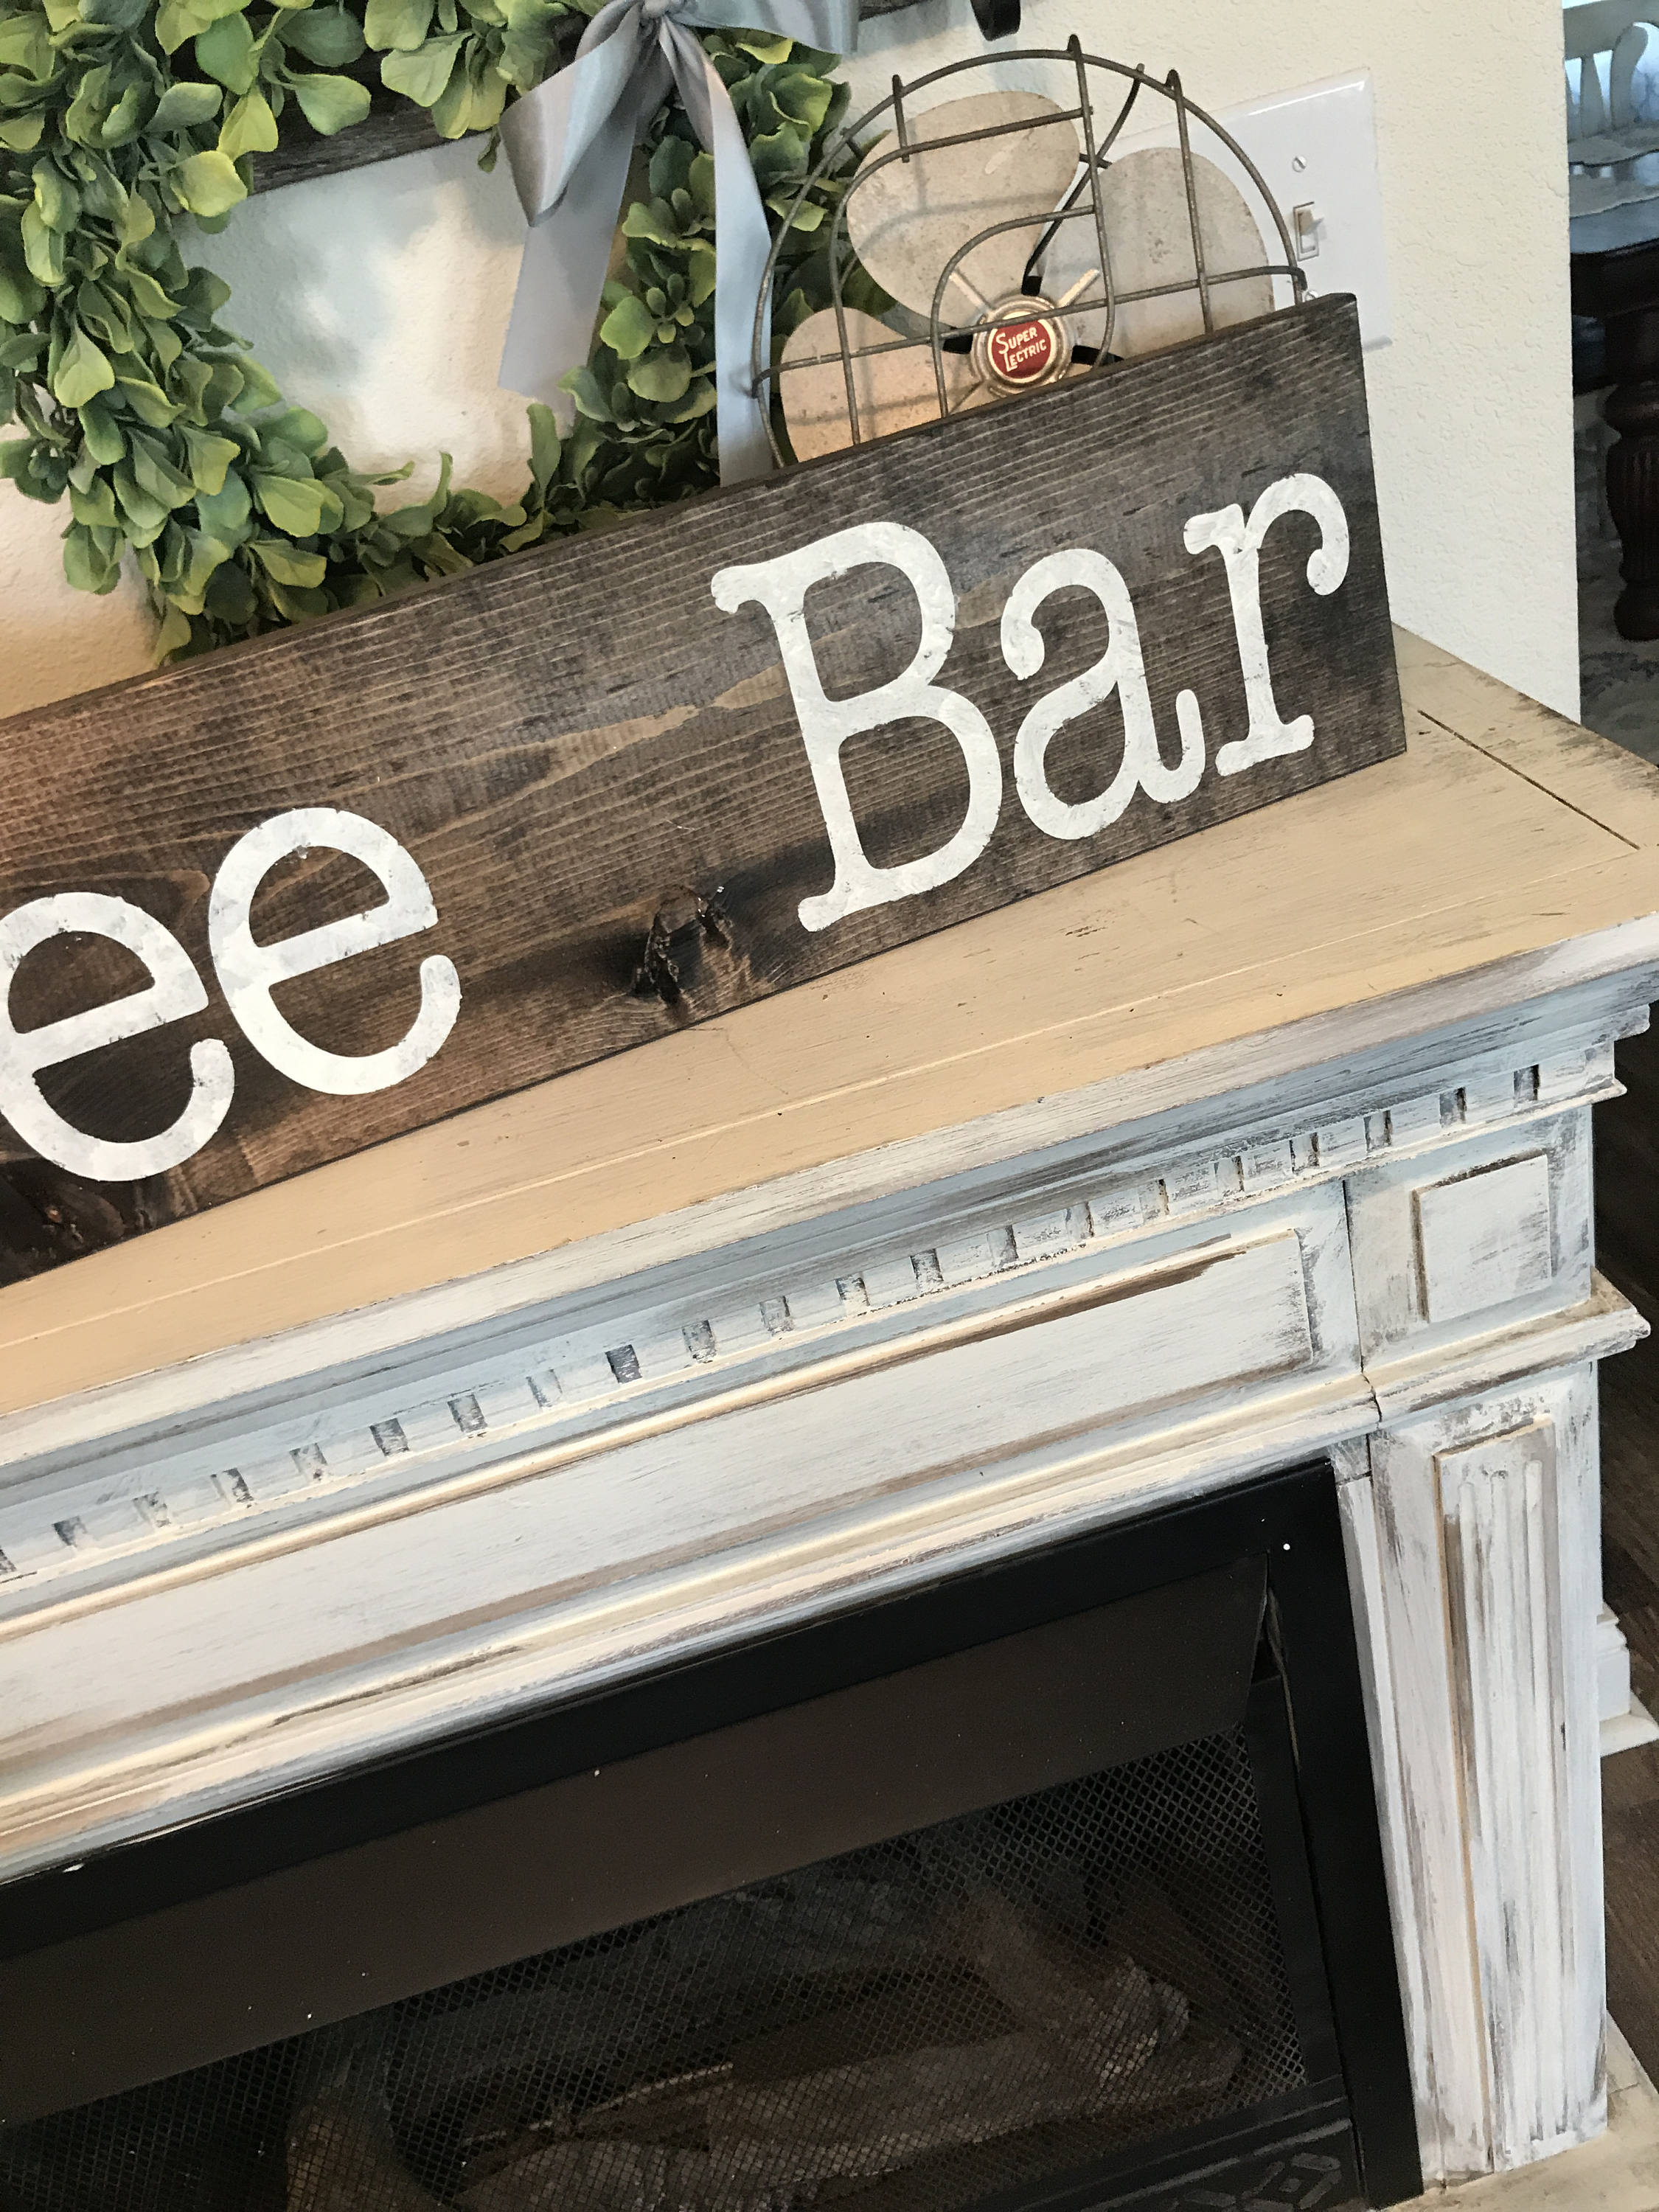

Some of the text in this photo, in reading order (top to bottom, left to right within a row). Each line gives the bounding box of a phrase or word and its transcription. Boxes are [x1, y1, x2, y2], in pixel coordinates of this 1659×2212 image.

[996, 327, 1038, 355] SUPER
[1004, 339, 1047, 372] LECTRIC
[710, 473, 1350, 932] Bar
